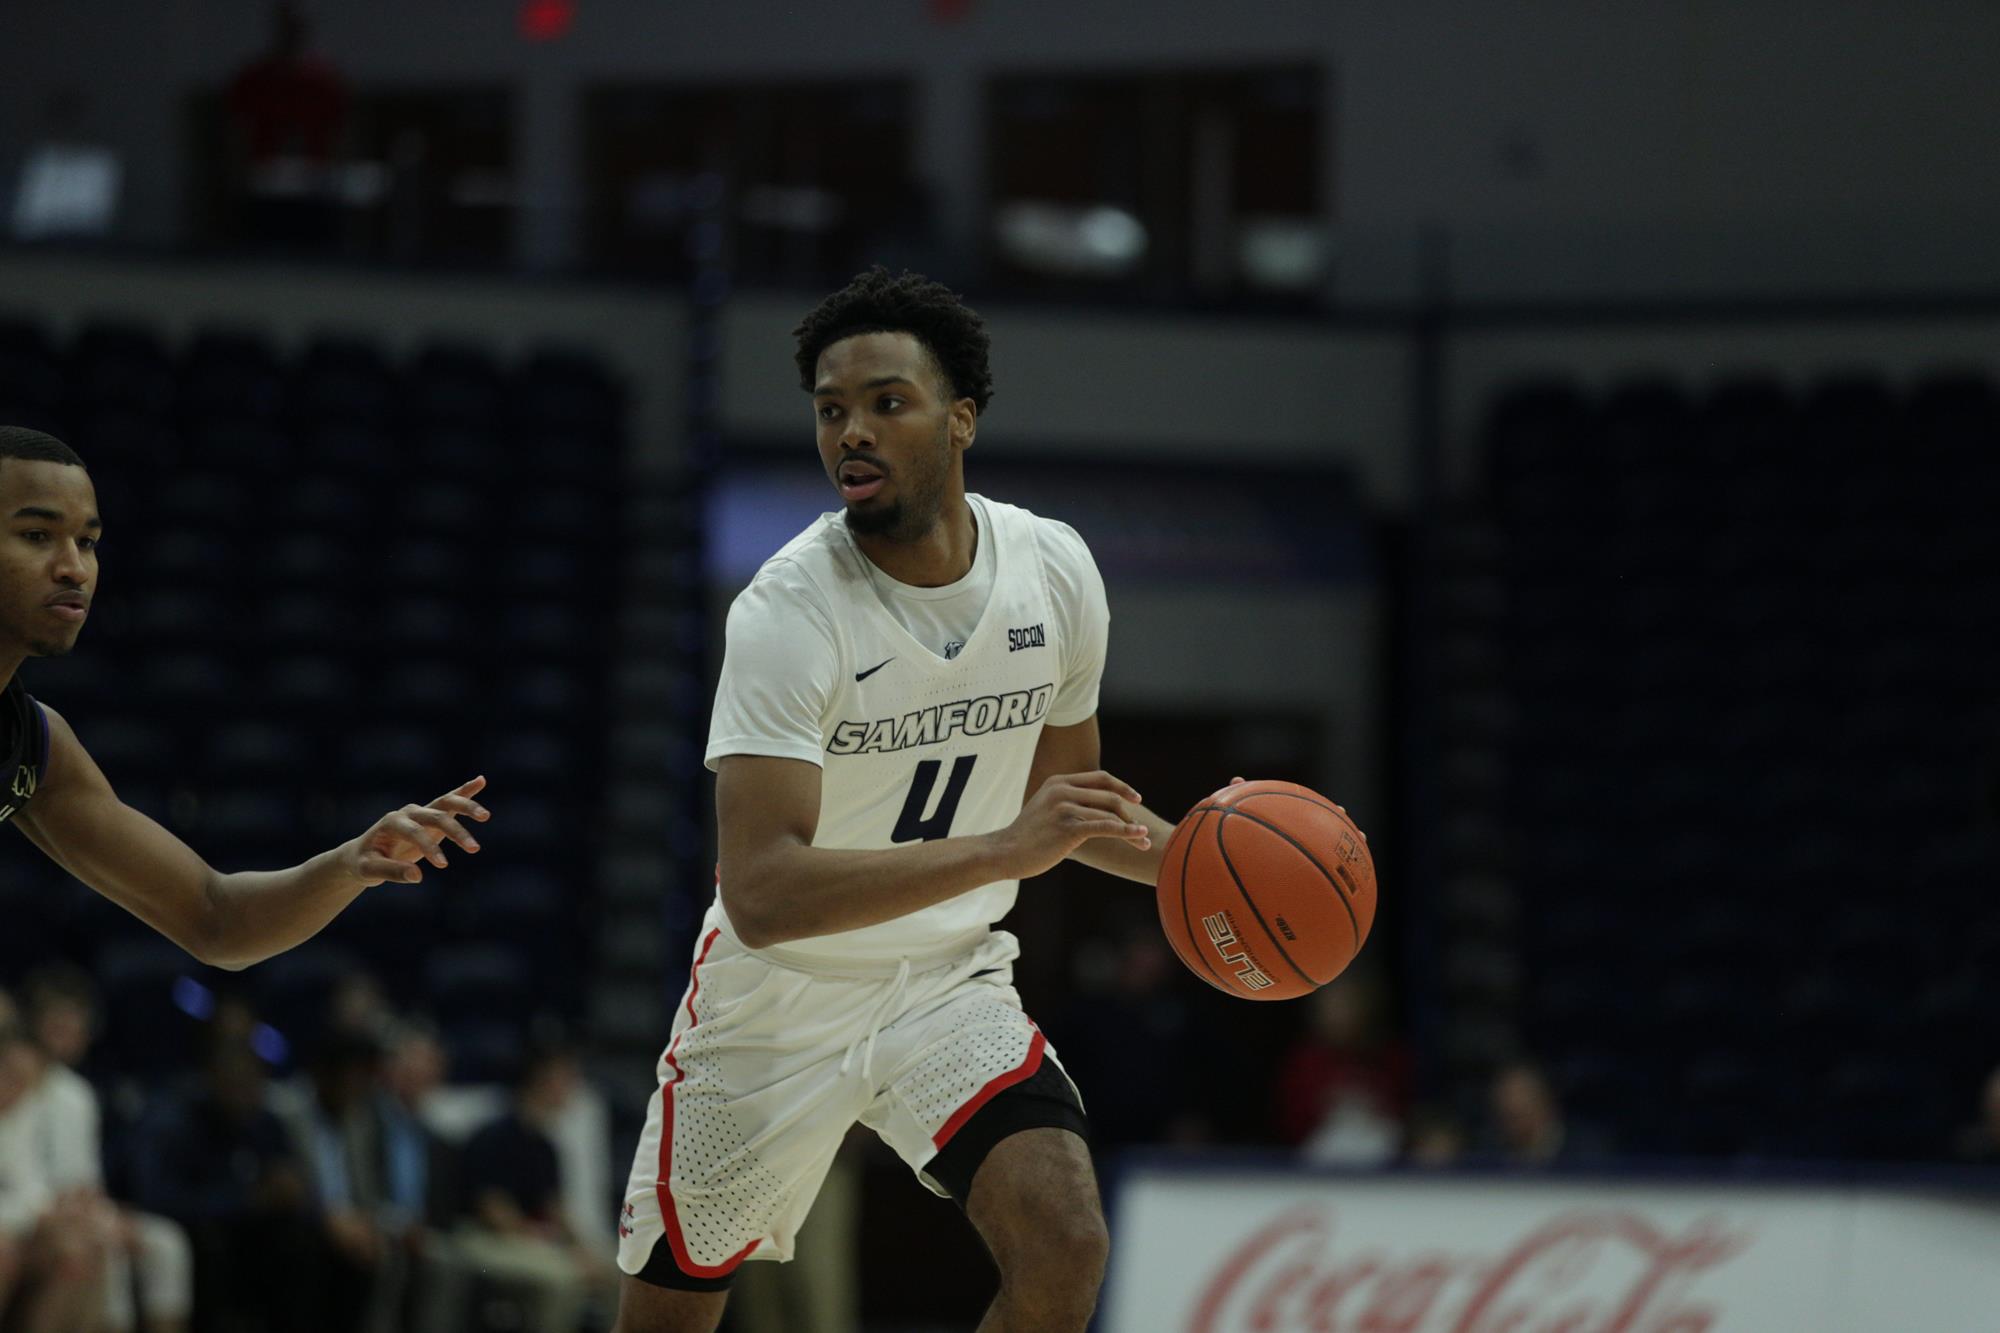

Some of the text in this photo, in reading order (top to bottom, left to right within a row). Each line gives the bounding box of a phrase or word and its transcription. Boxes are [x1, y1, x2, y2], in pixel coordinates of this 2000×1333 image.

[1008, 623, 1045, 651] SOCON
[826, 683, 1054, 755] SAMFORD
[890, 754, 978, 843] 4
[1202, 911, 1275, 991] ELITE
